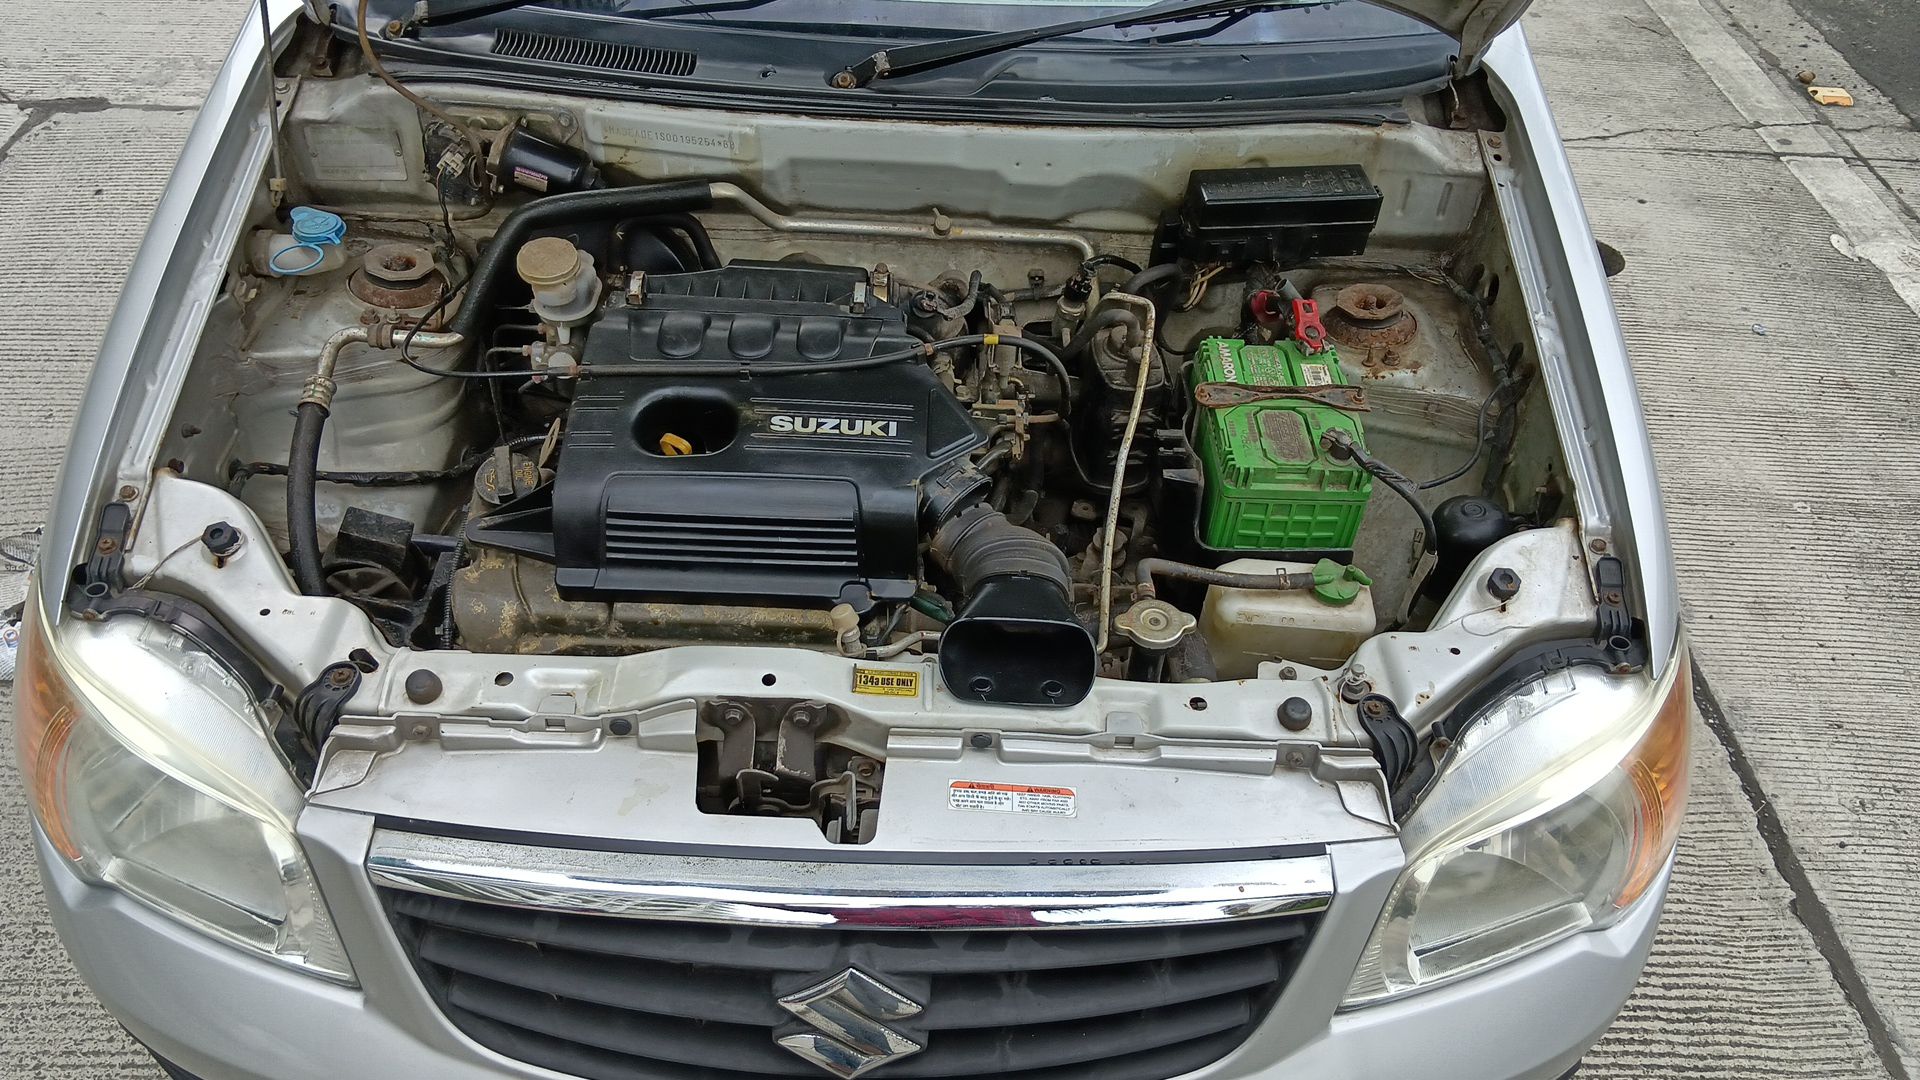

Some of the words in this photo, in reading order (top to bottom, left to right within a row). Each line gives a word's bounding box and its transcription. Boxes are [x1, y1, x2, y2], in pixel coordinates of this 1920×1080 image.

[1216, 340, 1238, 383] AMARON
[769, 415, 898, 437] SUZUKI
[523, 462, 534, 485] ENGINE
[880, 677, 895, 687] USE
[896, 677, 914, 687] ONLY
